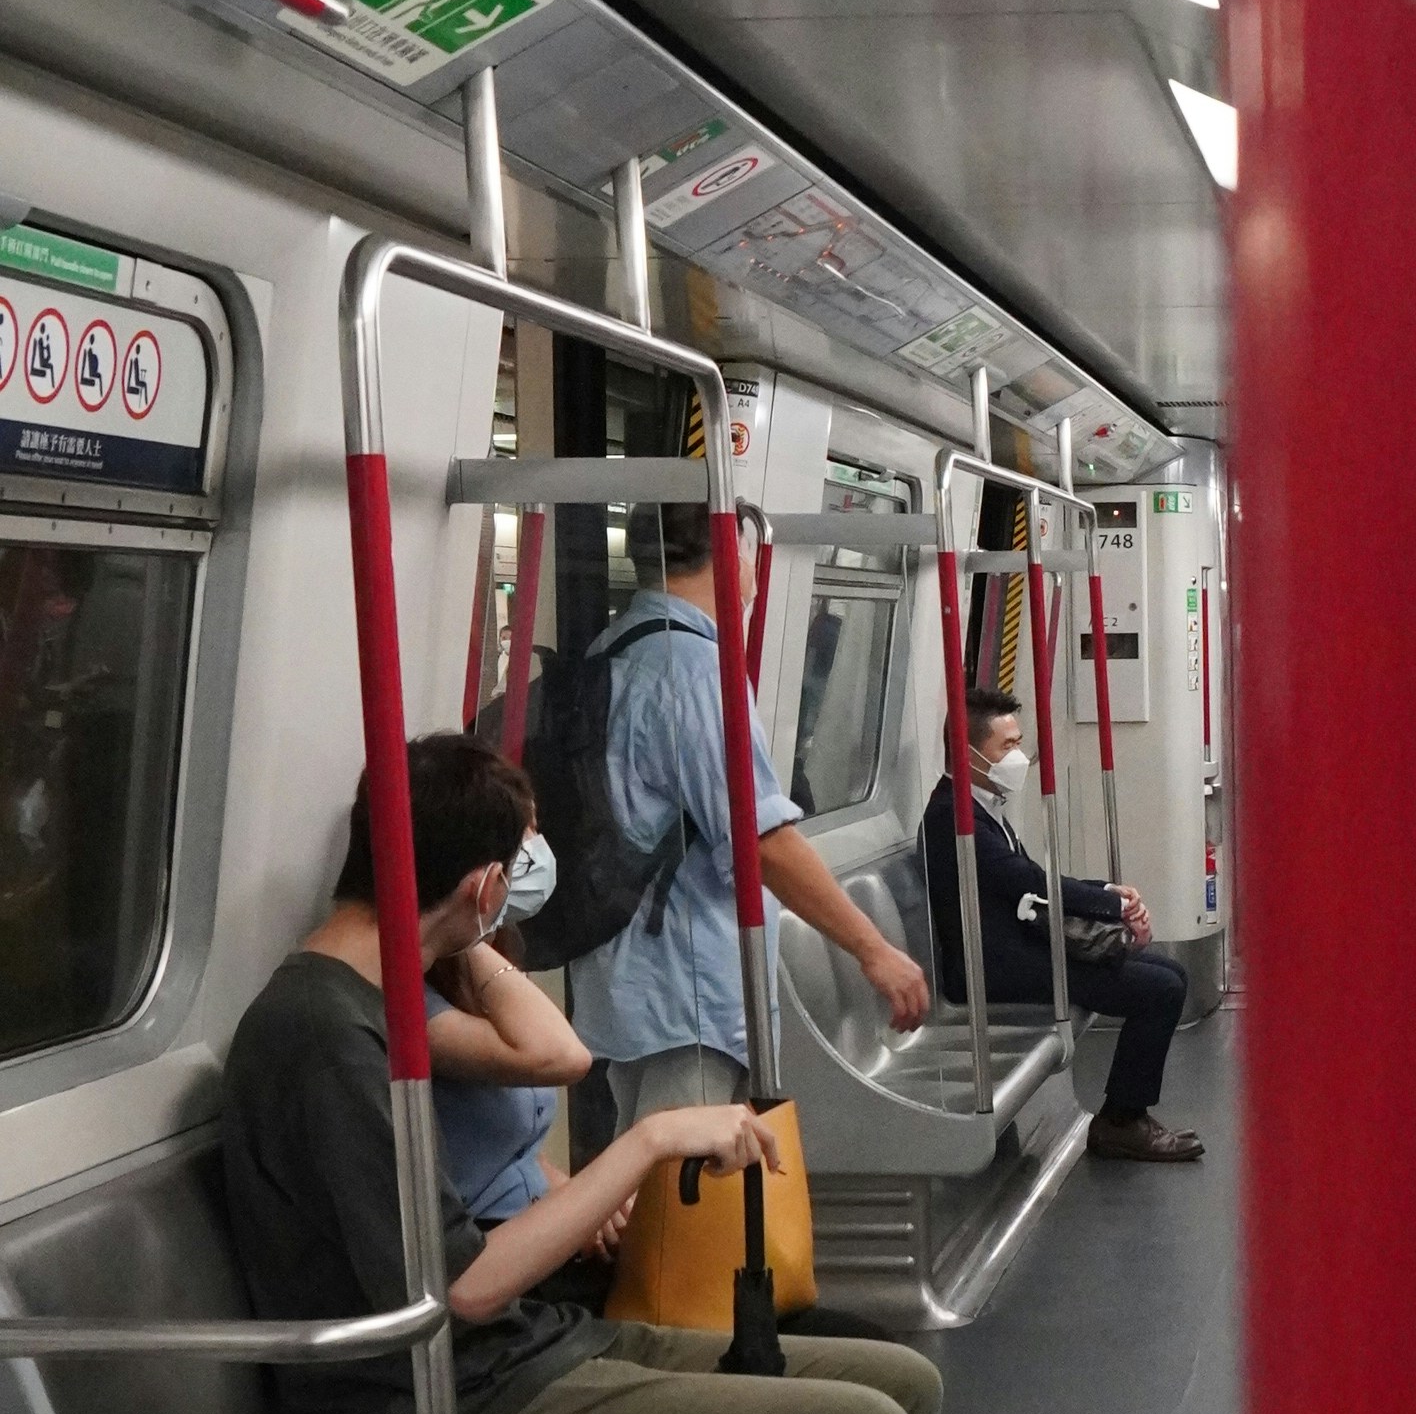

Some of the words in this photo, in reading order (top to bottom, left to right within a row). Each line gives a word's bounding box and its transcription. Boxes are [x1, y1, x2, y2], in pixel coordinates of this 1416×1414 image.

[737, 397, 750, 408] A4
[14, 449, 31, 461] Please
[1084, 533, 1133, 550] 748
